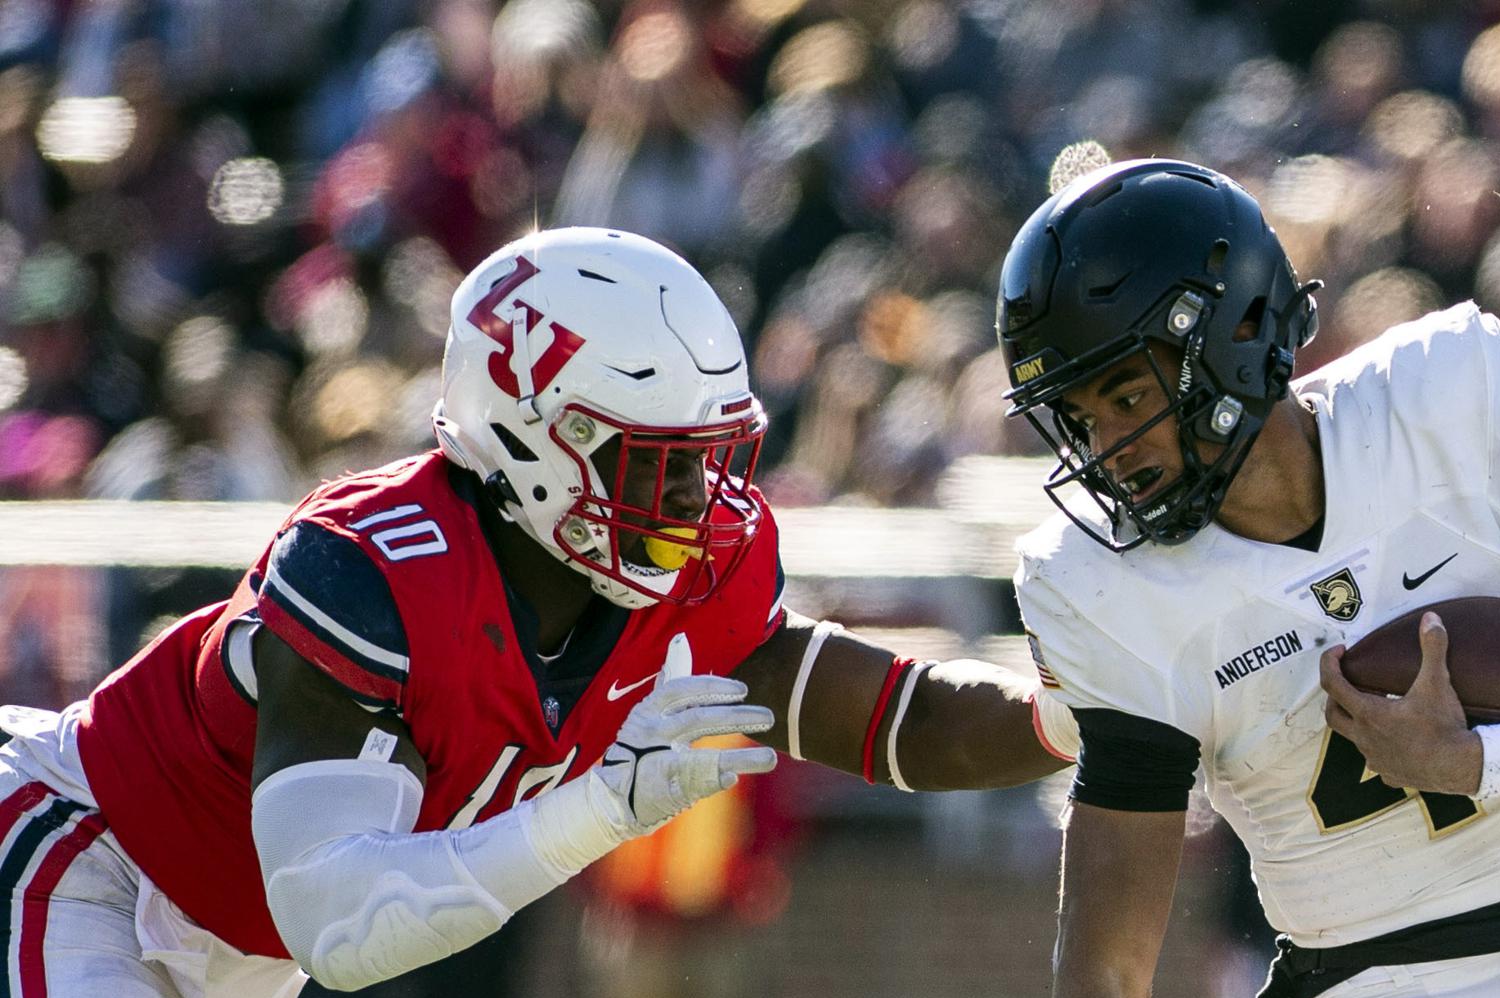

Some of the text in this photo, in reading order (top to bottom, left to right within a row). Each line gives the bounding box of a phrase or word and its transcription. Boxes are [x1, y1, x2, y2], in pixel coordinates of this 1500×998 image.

[1014, 357, 1045, 384] ARMY
[344, 502, 450, 563] 10
[1213, 629, 1304, 690] ANDERSON
